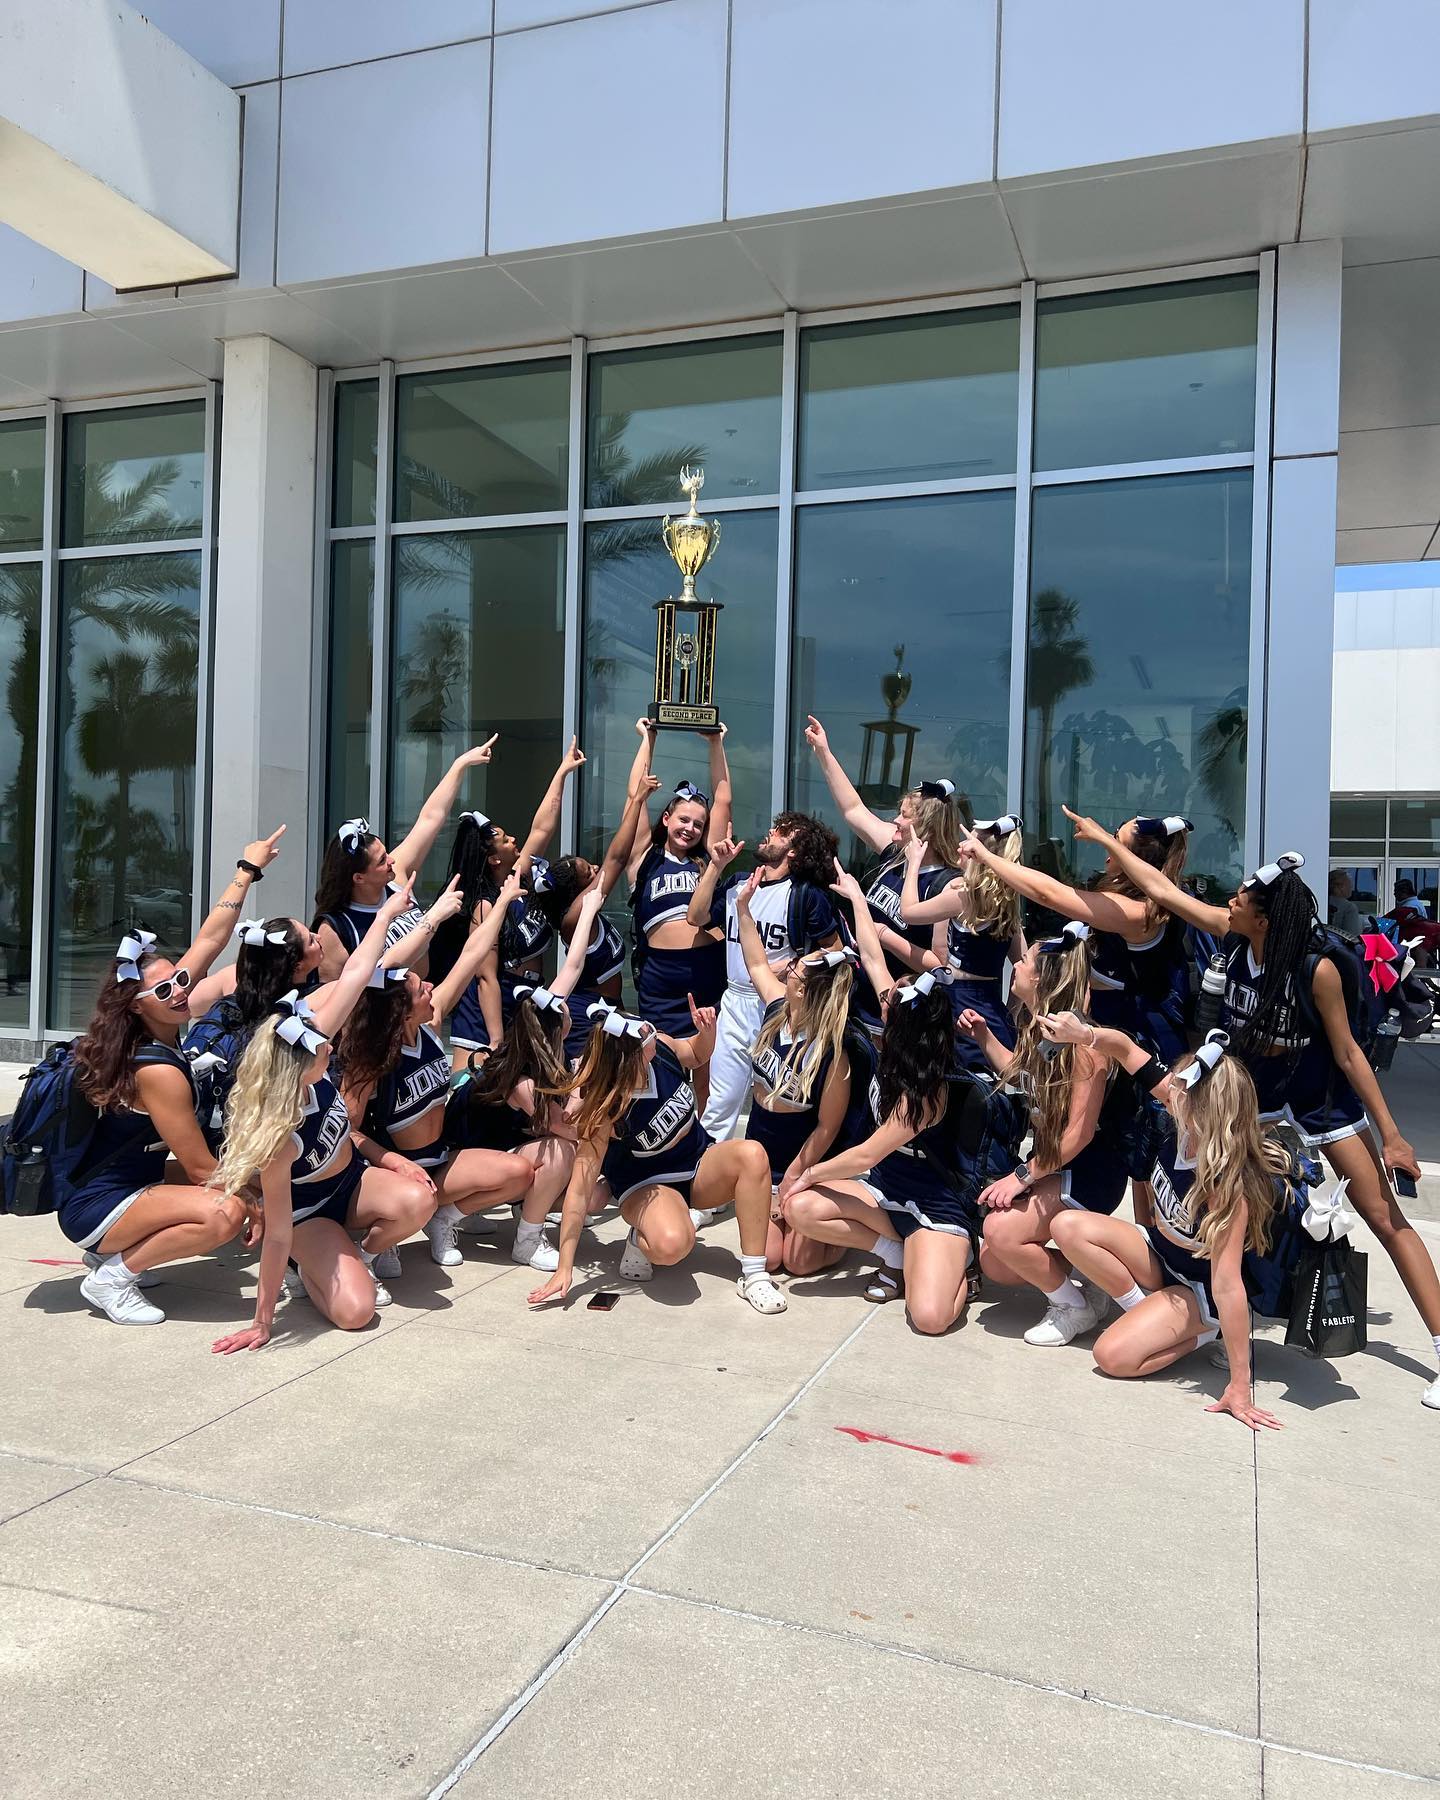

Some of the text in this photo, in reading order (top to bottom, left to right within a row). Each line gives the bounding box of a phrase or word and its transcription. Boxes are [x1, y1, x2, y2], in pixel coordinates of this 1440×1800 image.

[663, 711, 689, 719] SECOND
[691, 712, 713, 720] PLACE
[650, 870, 701, 902] LION
[728, 915, 787, 950] LNS
[305, 1093, 349, 1170] LION
